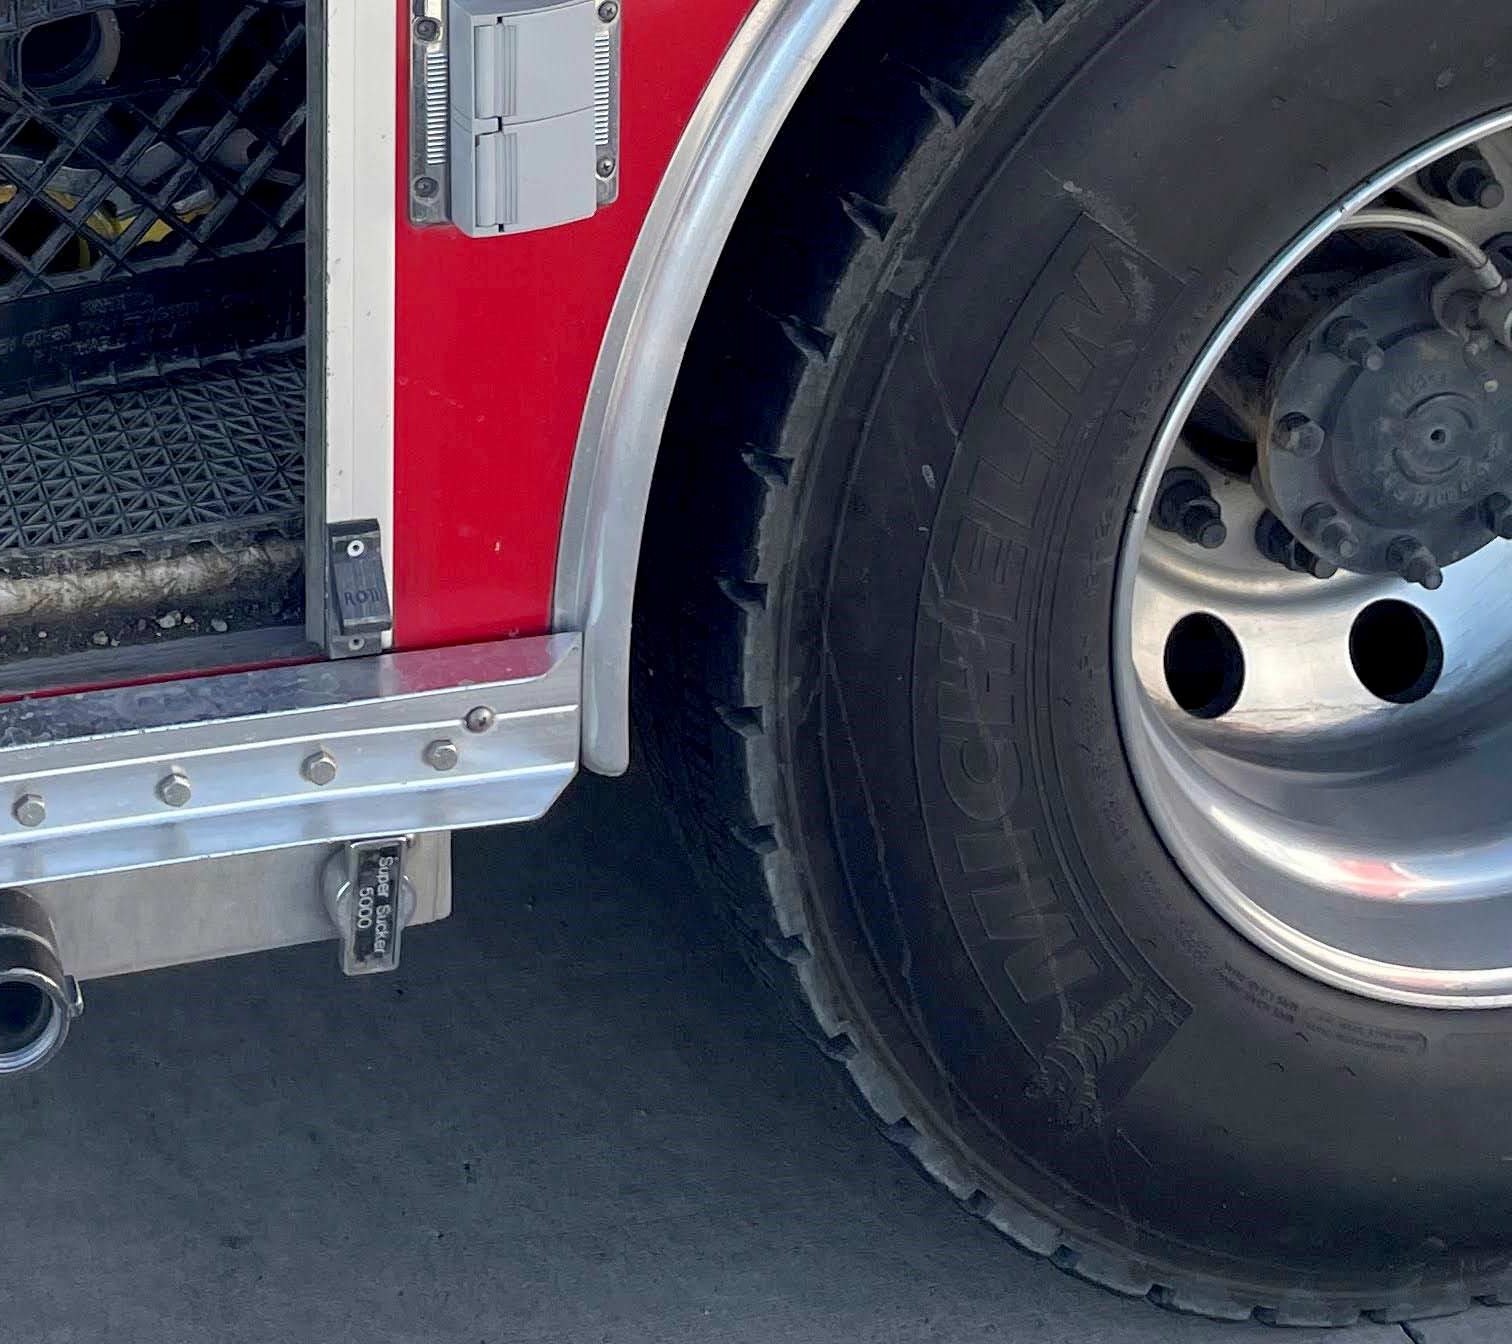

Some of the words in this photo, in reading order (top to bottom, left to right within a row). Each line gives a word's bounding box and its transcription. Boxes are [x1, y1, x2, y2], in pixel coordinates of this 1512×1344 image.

[376, 856, 394, 898] Super
[357, 887, 374, 929] 5000
[373, 904, 392, 954] Sucker
